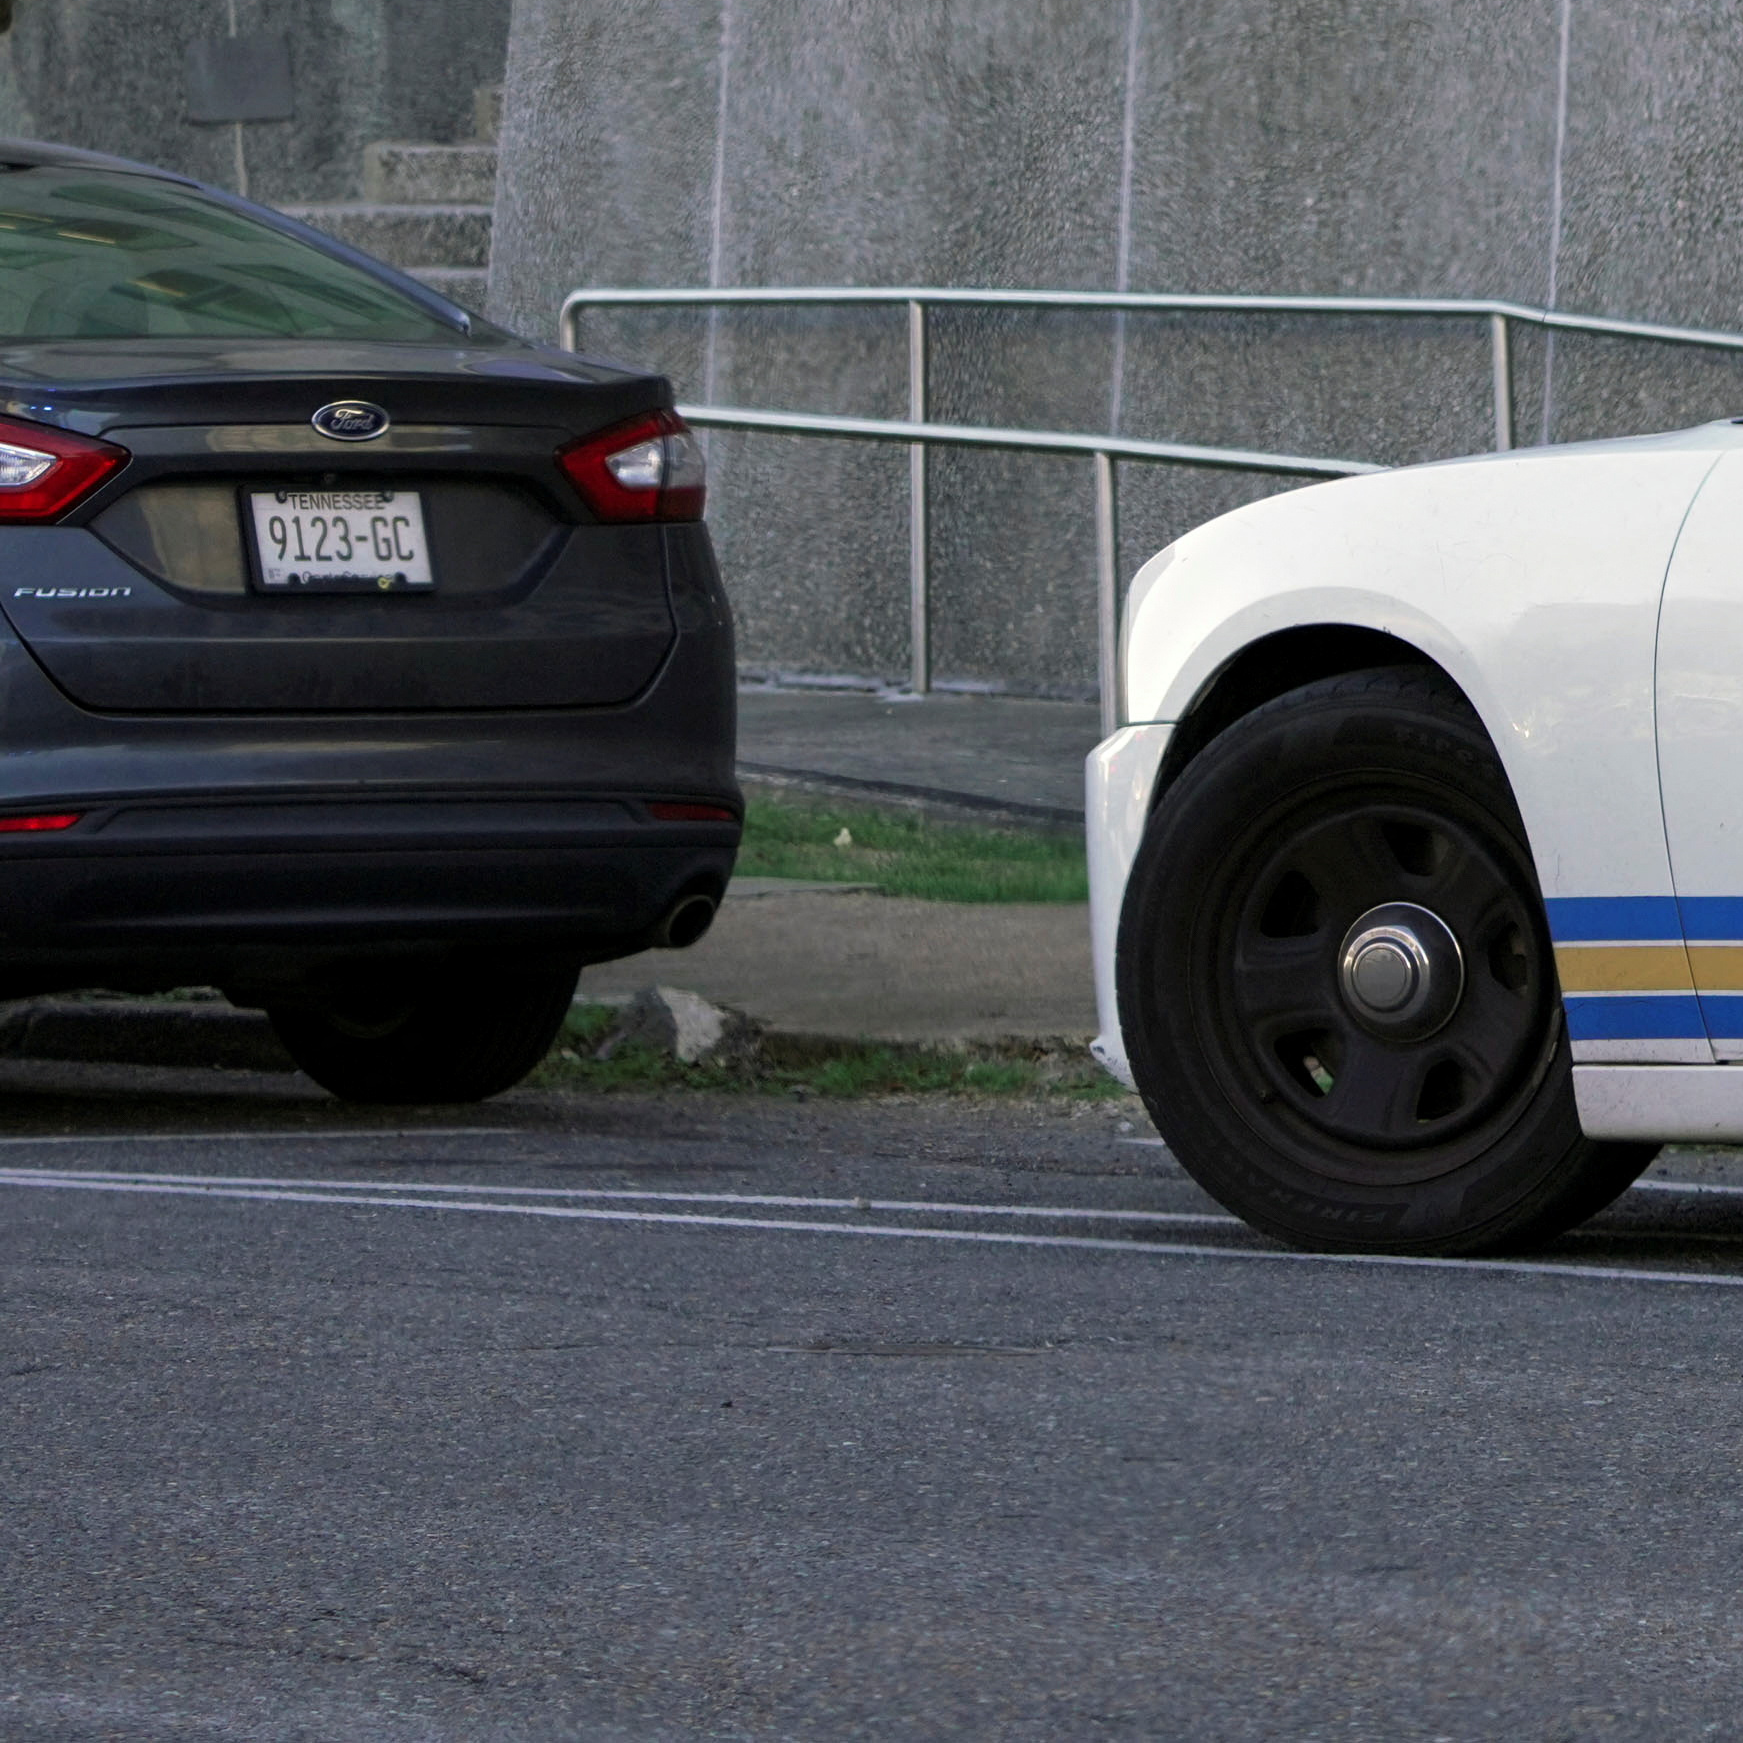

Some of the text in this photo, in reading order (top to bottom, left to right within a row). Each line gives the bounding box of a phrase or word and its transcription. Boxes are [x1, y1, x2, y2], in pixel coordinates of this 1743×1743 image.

[330, 408, 375, 431] Ford
[288, 493, 387, 511] TENNESSEE
[268, 515, 415, 562] 9123-GC
[14, 586, 132, 598] FUSION
